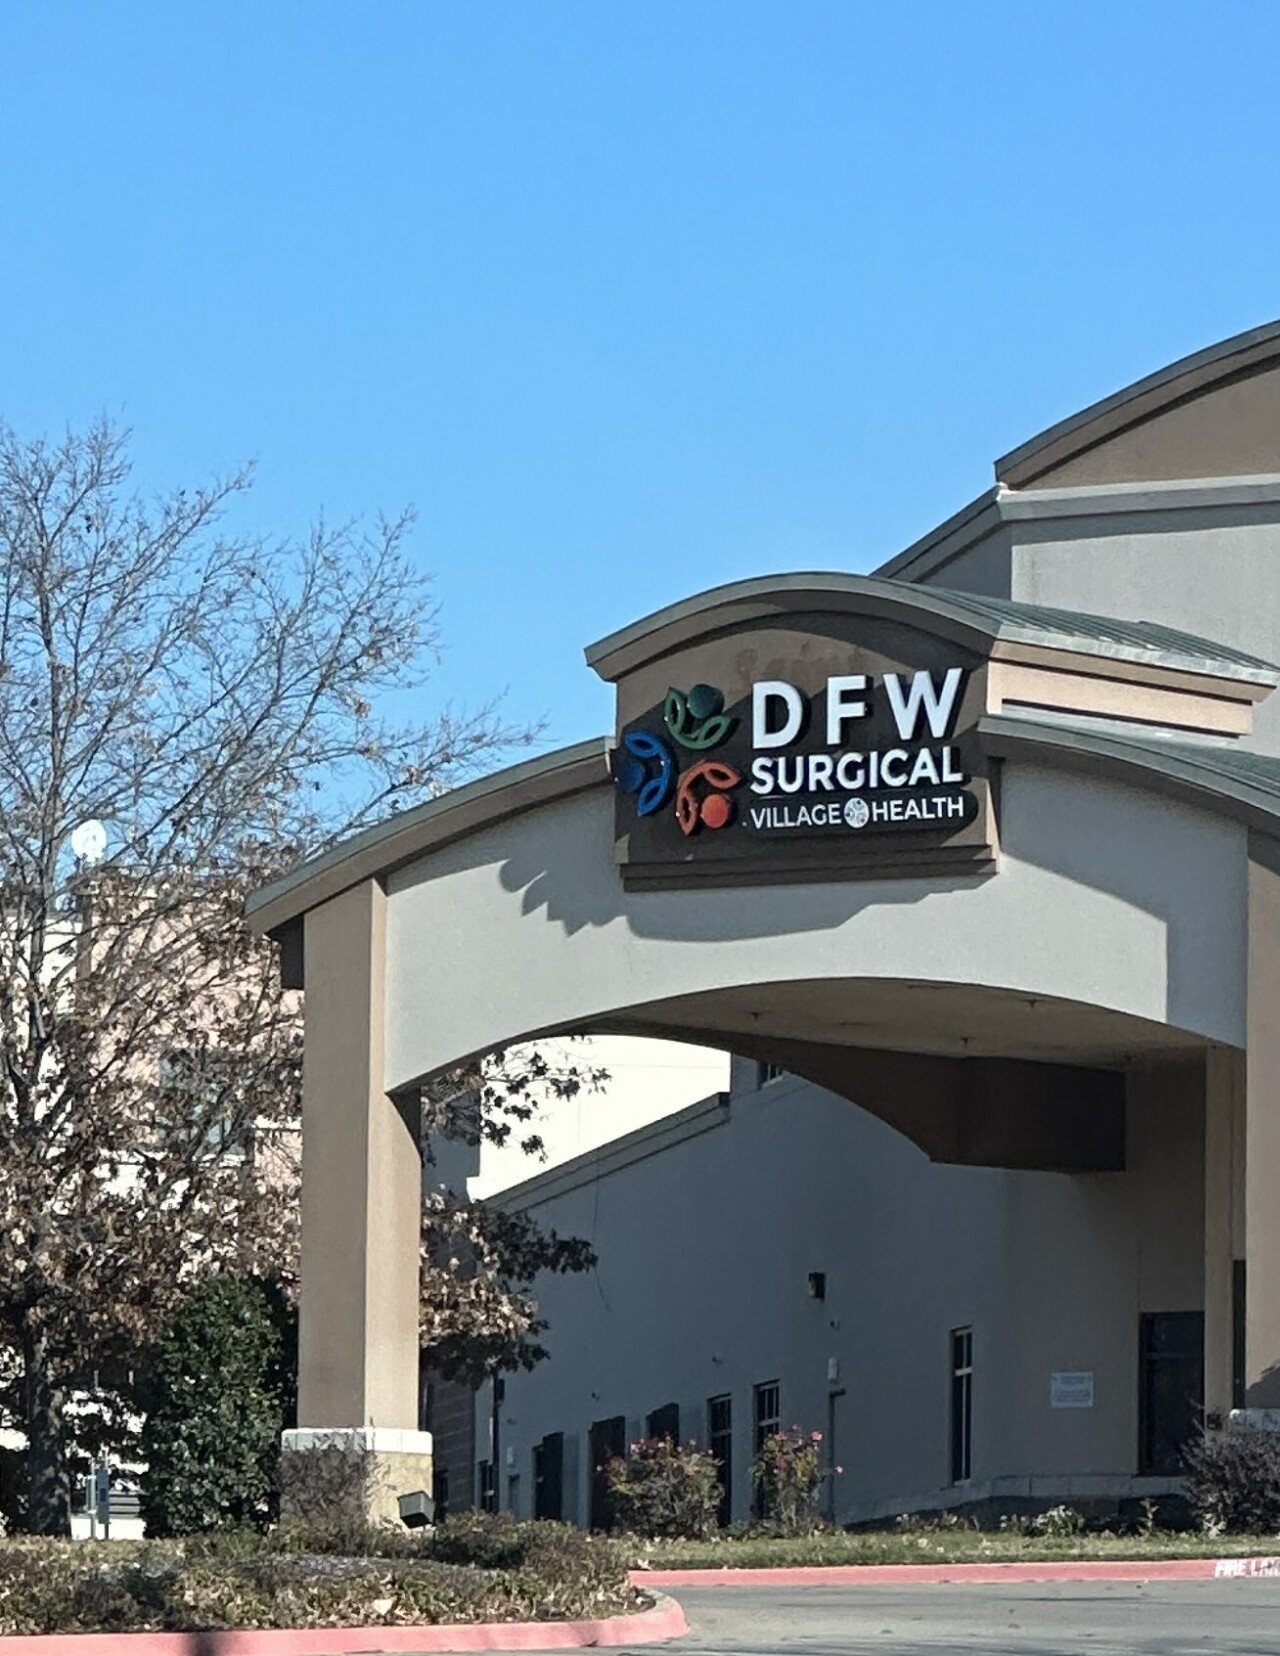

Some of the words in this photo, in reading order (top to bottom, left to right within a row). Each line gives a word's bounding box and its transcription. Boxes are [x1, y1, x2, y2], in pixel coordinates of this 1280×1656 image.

[750, 746, 963, 795] SURGICAL
[750, 803, 842, 829] VILLAGE
[872, 796, 964, 822] HEALTH
